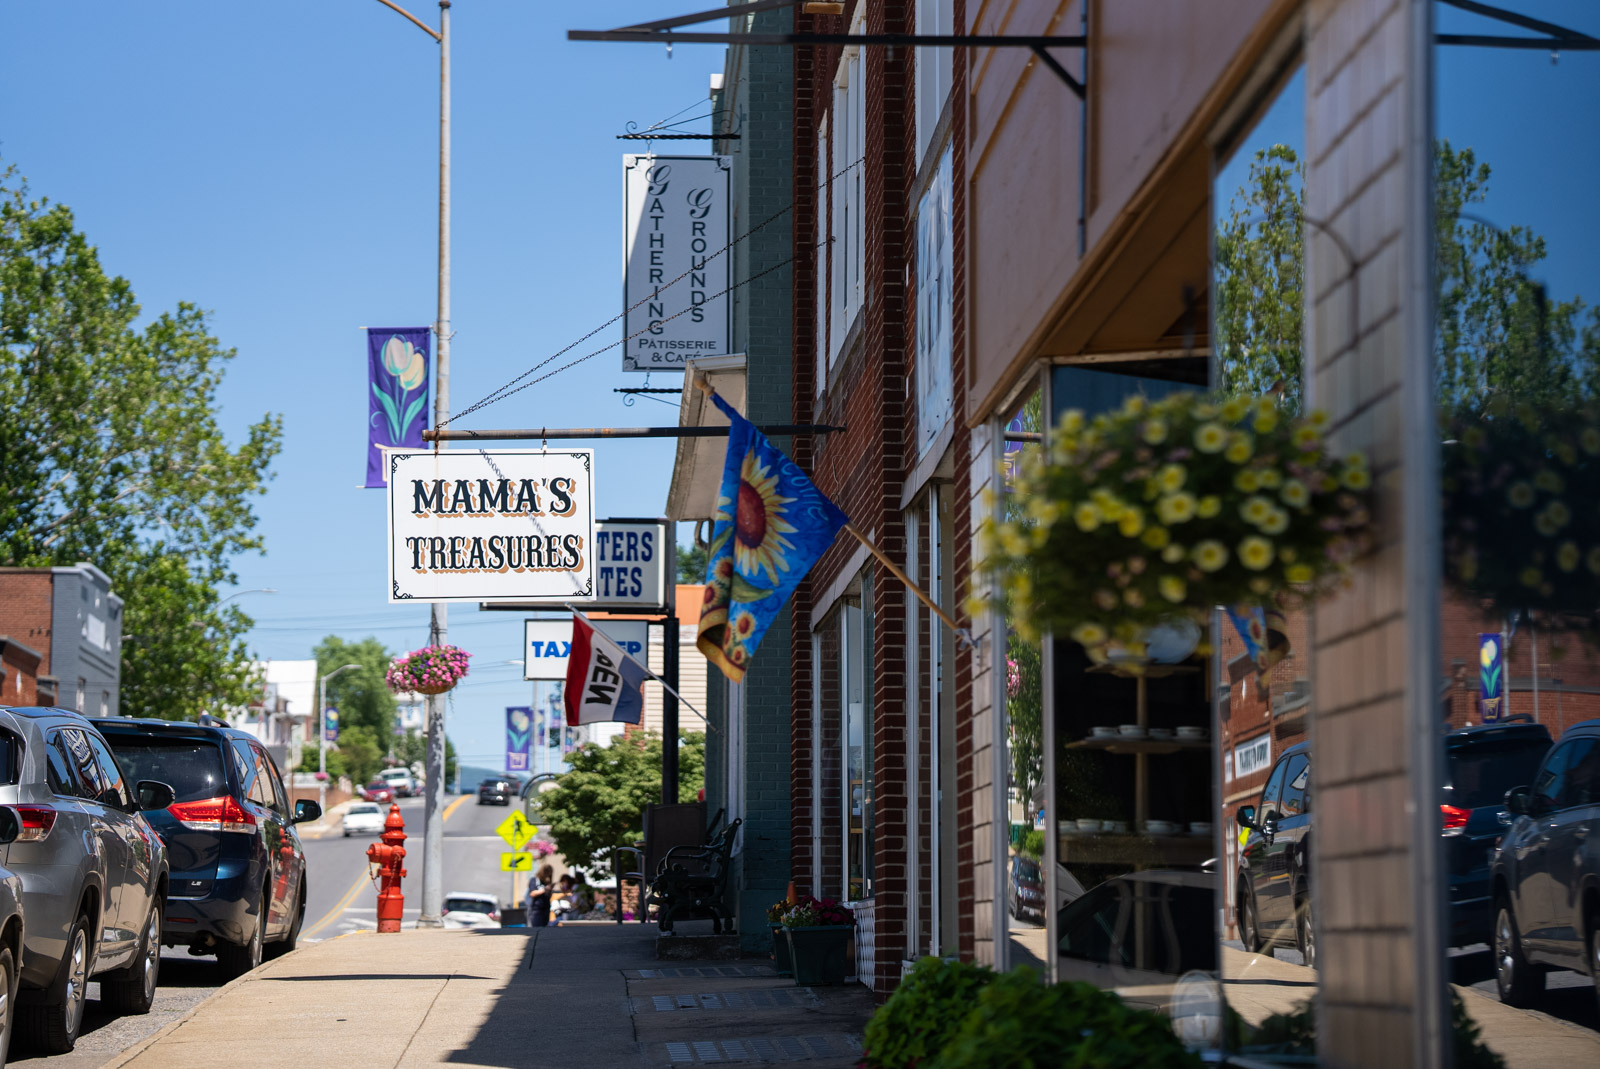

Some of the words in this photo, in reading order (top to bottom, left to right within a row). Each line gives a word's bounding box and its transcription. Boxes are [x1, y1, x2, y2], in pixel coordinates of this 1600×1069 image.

[644, 164, 672, 336] GATHERING
[686, 187, 714, 323] GROUNDS
[651, 351, 663, 363] &
[410, 476, 577, 518] MAMA'S
[405, 534, 584, 574] TREASURES
[596, 530, 653, 562] TERS
[596, 566, 642, 597] TES
[531, 640, 573, 658] TAX
